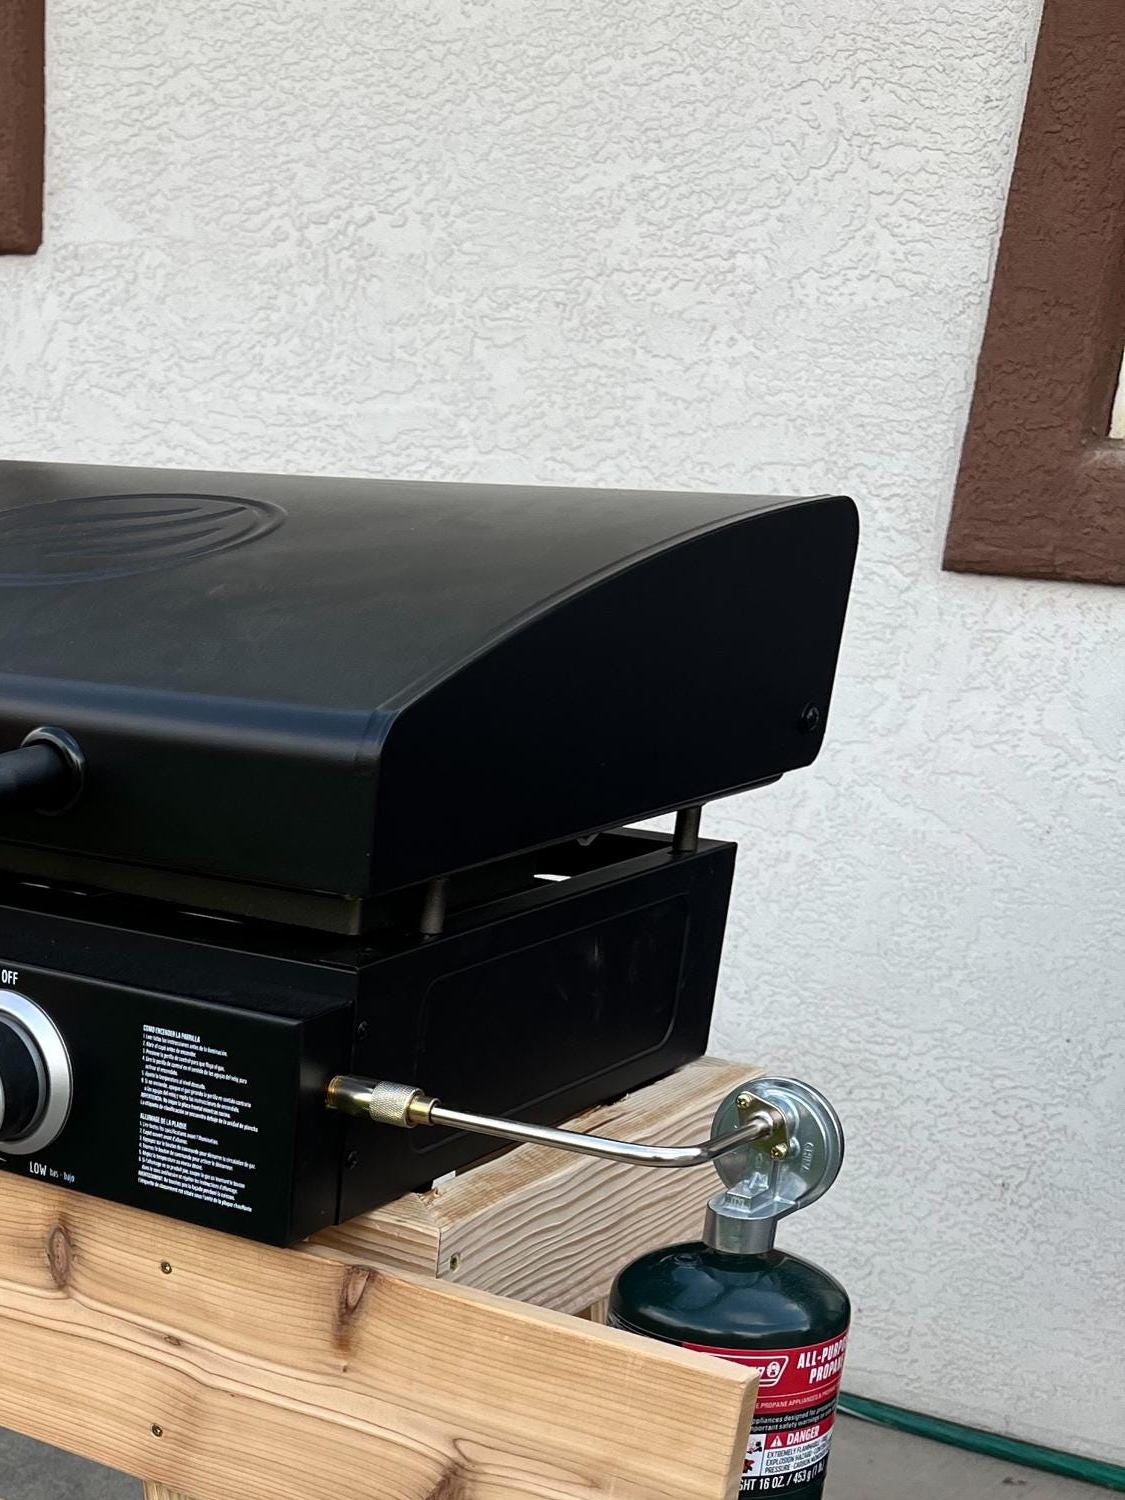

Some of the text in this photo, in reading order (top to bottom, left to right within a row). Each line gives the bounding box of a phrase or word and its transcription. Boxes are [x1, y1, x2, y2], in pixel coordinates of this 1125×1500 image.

[1, 969, 19, 985] OFF
[29, 1160, 47, 1177] LOW
[786, 1426, 819, 1445] DANGER
[759, 1477, 770, 1490] 16
[786, 1473, 793, 1486] /
[793, 1469, 806, 1484] 453
